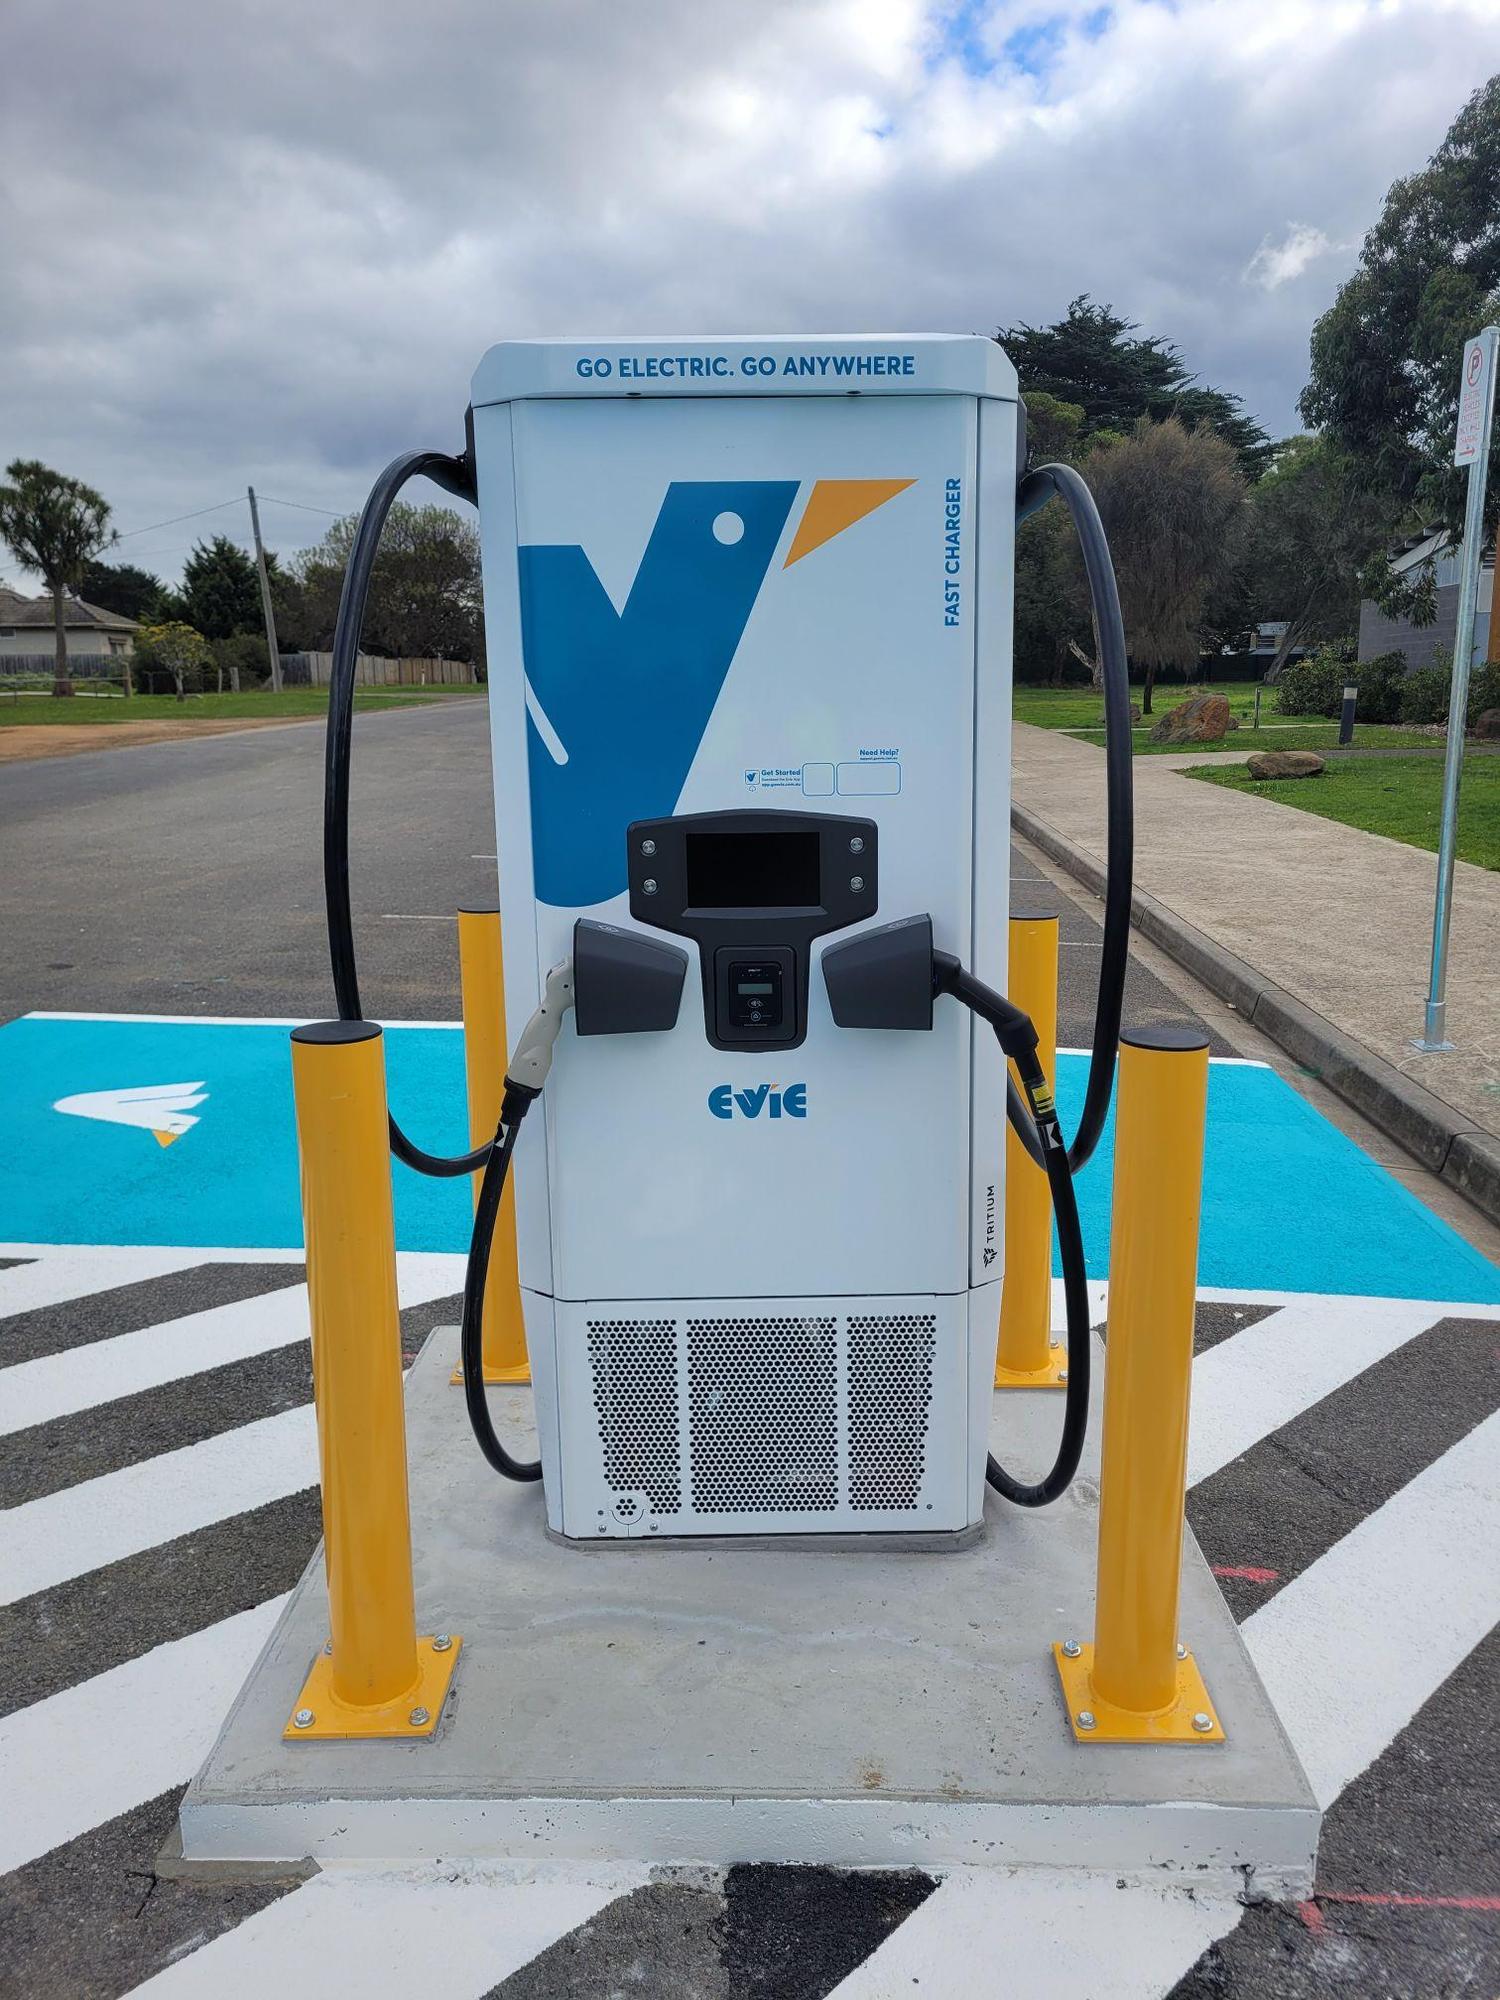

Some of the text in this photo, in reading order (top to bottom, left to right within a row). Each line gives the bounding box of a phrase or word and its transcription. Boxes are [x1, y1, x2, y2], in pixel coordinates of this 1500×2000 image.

[576, 355, 915, 378] GO ELECTRIC. GO ANYWHERE
[944, 478, 961, 627] FAST CHARGER
[880, 748, 899, 757] Help?
[775, 768, 801, 776] Started
[986, 1185, 995, 1244] TRITIUM
